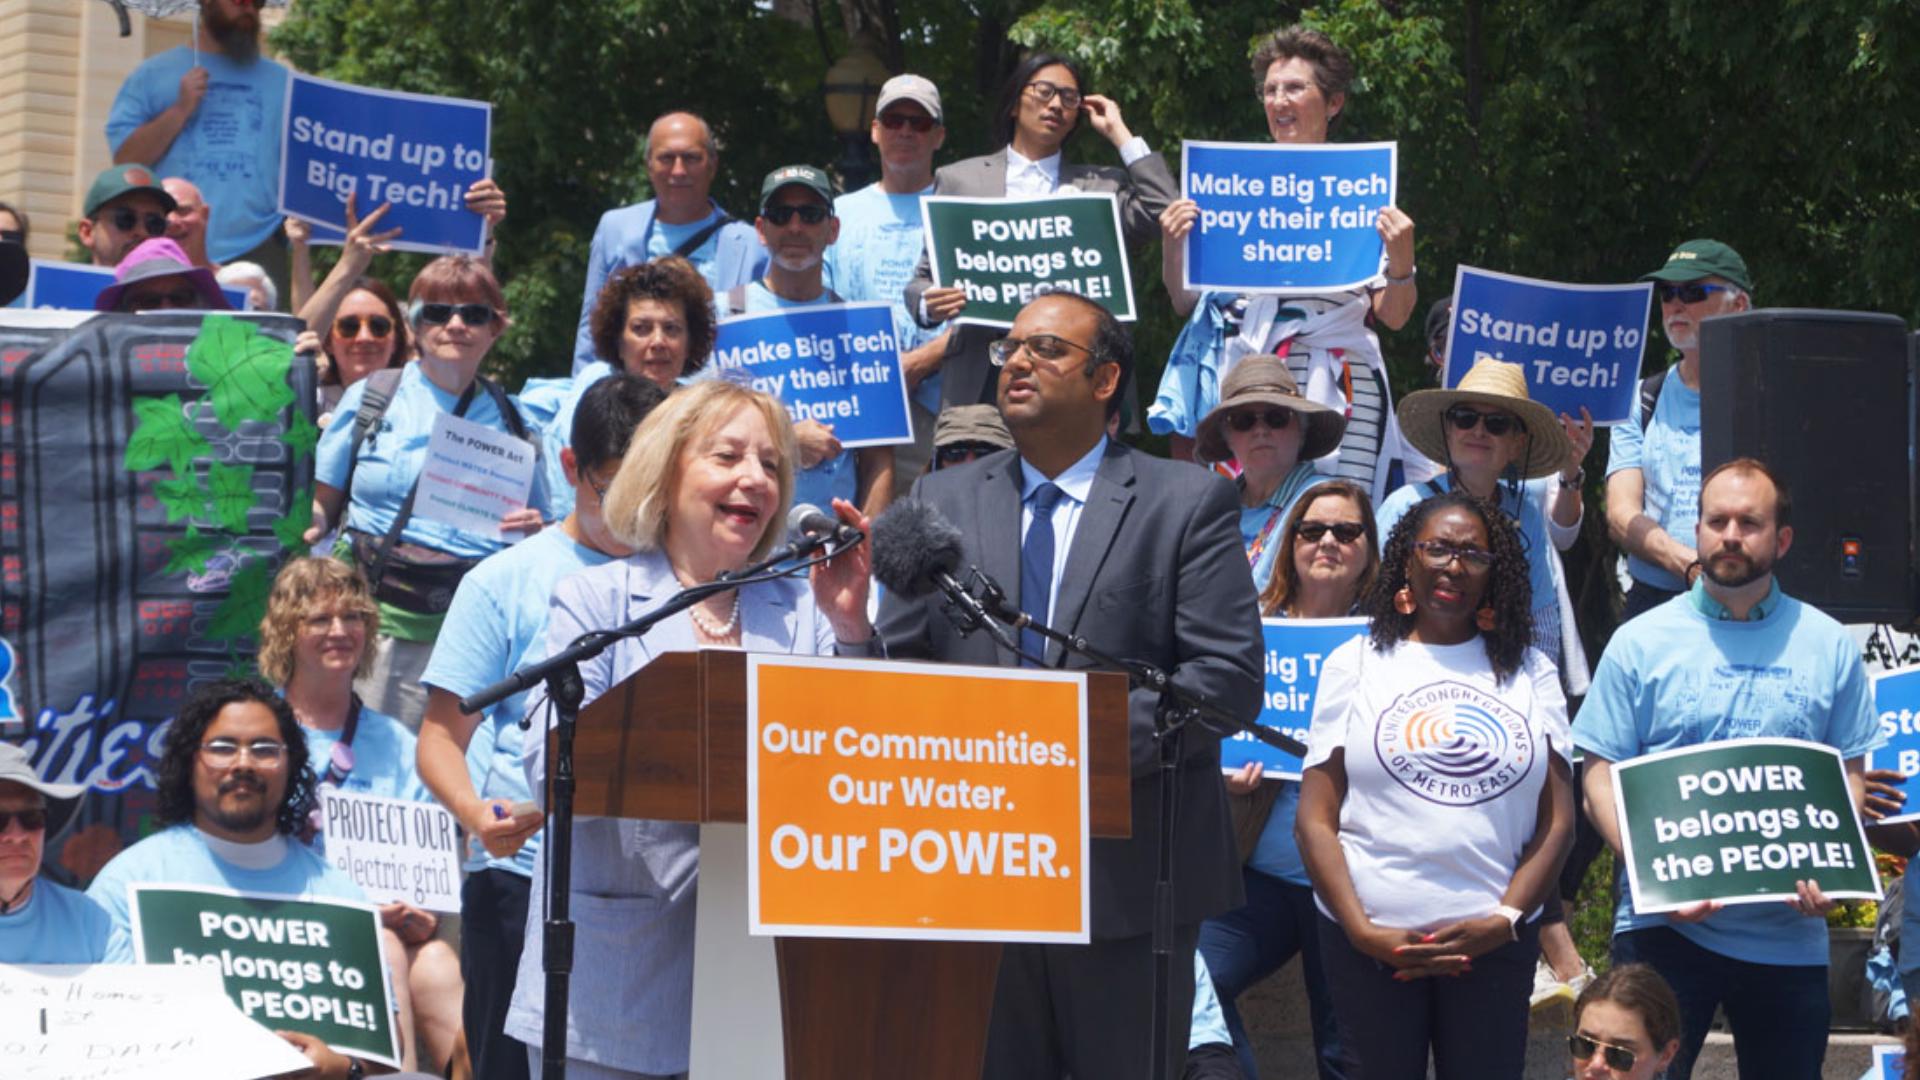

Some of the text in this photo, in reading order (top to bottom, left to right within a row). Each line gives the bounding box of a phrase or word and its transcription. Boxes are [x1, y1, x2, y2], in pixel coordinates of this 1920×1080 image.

[293, 116, 483, 175] Stand up to
[307, 160, 462, 211] Big Tech!
[1190, 171, 1388, 204] Make Big Tech
[972, 216, 1074, 242] POWER
[1201, 204, 1377, 236] pay their fair
[955, 246, 1102, 279] belongs to
[1242, 239, 1333, 263] share!
[953, 278, 998, 302] the
[718, 330, 895, 369] Make Big Tech
[1459, 308, 1640, 358] Stand up to
[751, 360, 891, 398] ay their fair
[1532, 359, 1620, 388] Tech!
[445, 430, 525, 464] The POWER Act
[1264, 686, 1310, 712] eir
[762, 721, 1076, 767] Our Communities.
[828, 773, 1015, 811] Our Water.
[1391, 755, 1518, 798] OF METRO-EAST
[1677, 765, 1806, 800] POWER
[327, 797, 453, 853] PROTECT OUR
[1654, 803, 1840, 843] belongs to
[770, 824, 1071, 879] Our POWER.
[1652, 842, 1856, 882] the PEOPLE!
[337, 845, 452, 905] electric grid
[199, 911, 331, 948] POWER
[327, 960, 365, 990] to
[240, 990, 378, 1031] PEOPLE!
